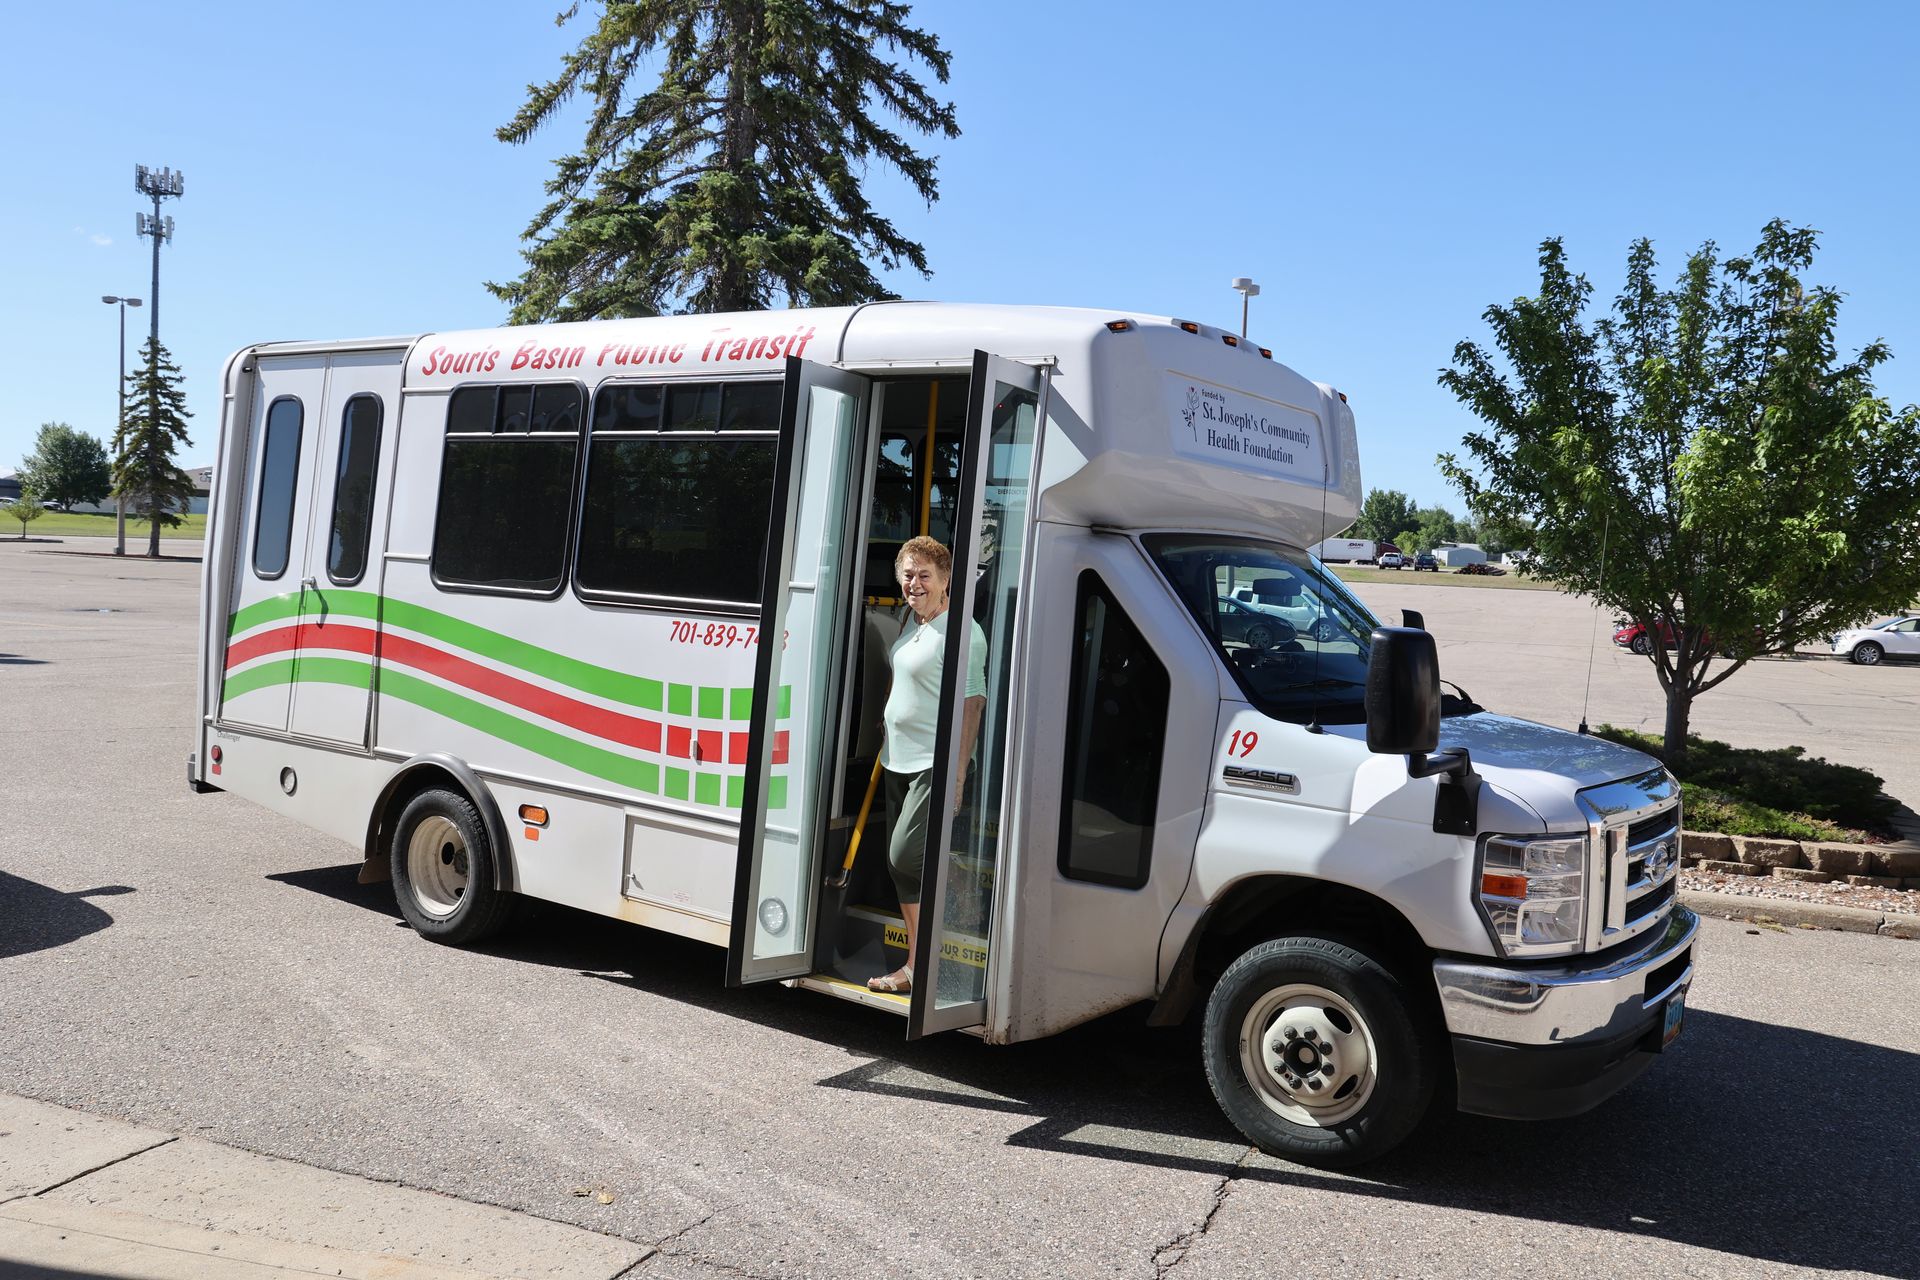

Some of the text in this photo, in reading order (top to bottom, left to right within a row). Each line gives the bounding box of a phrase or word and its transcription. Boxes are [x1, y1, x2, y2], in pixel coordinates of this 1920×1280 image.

[422, 325, 817, 376] Souris Basin Public Transit
[1202, 401, 1310, 448] St. Joseph's Community
[1207, 428, 1294, 465] Health Foundation
[1228, 729, 1259, 759] 19
